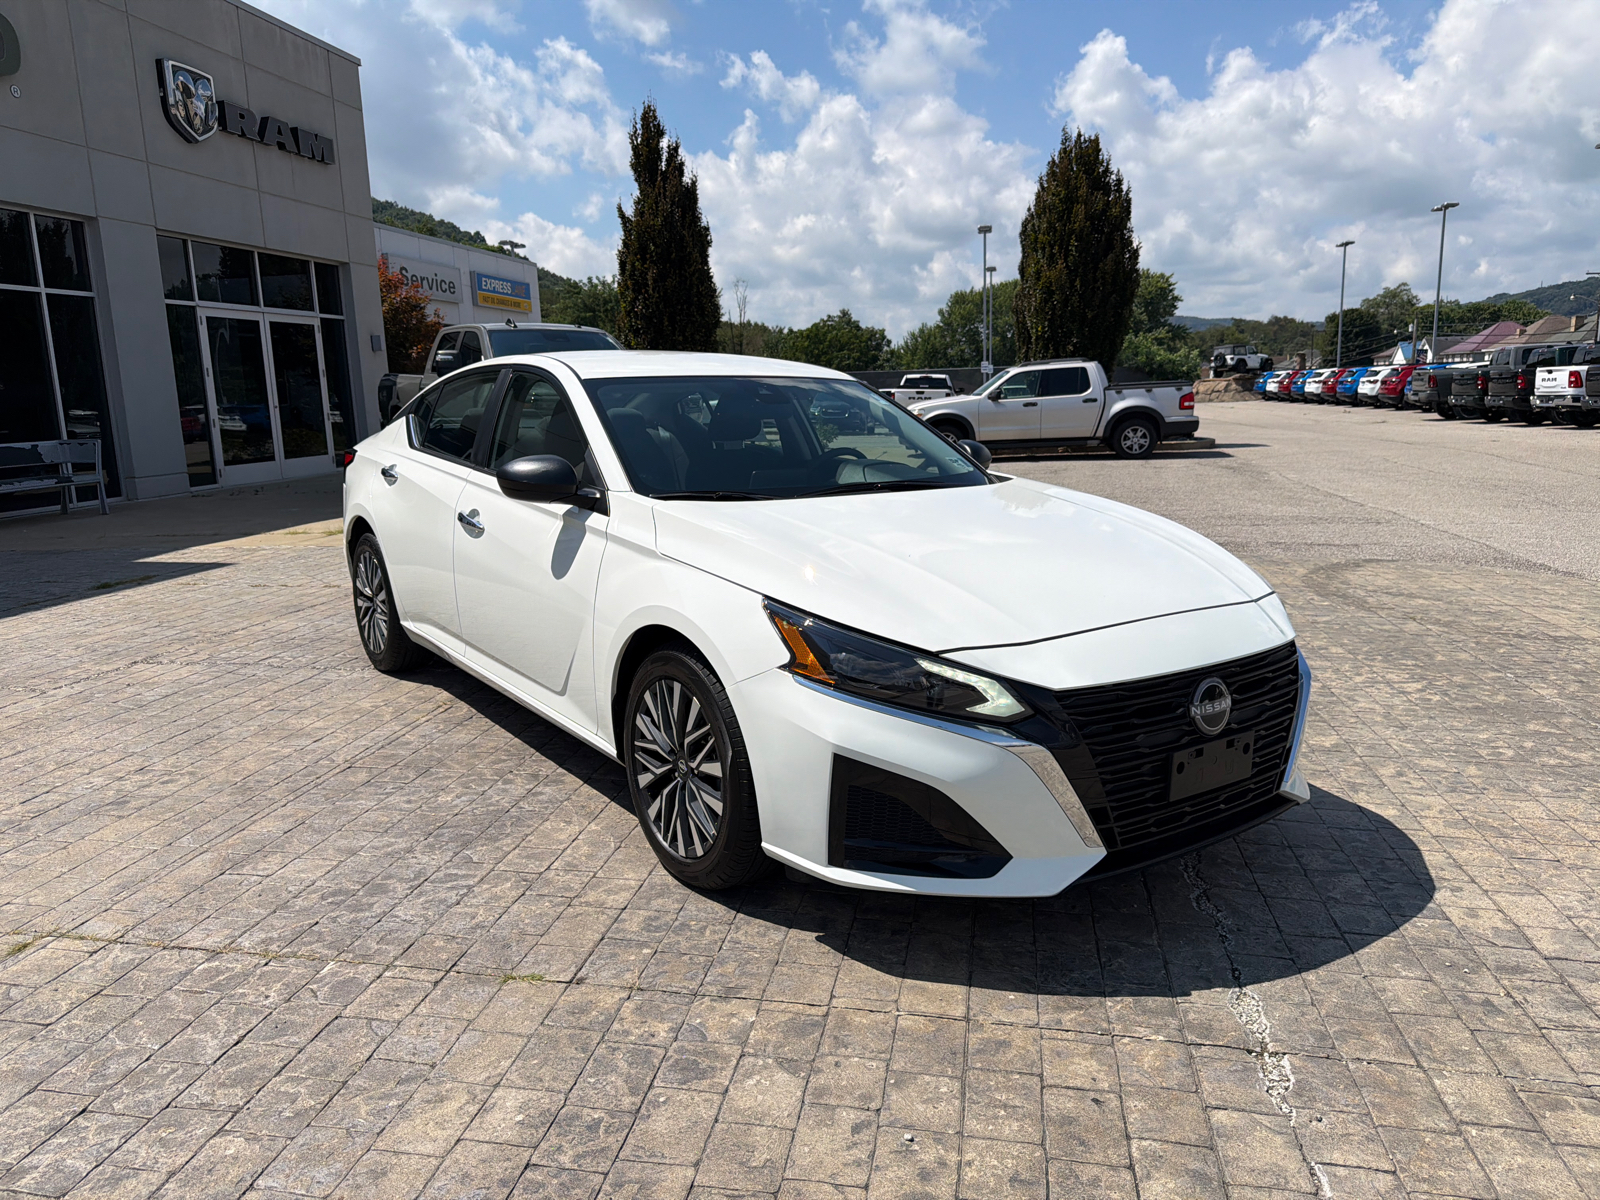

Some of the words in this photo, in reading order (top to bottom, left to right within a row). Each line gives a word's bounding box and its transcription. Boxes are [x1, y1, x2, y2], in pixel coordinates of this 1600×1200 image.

[217, 100, 336, 165] RAM
[399, 266, 456, 295] Service
[482, 277, 512, 295] EXPRESS
[1191, 697, 1231, 715] NISSAN
